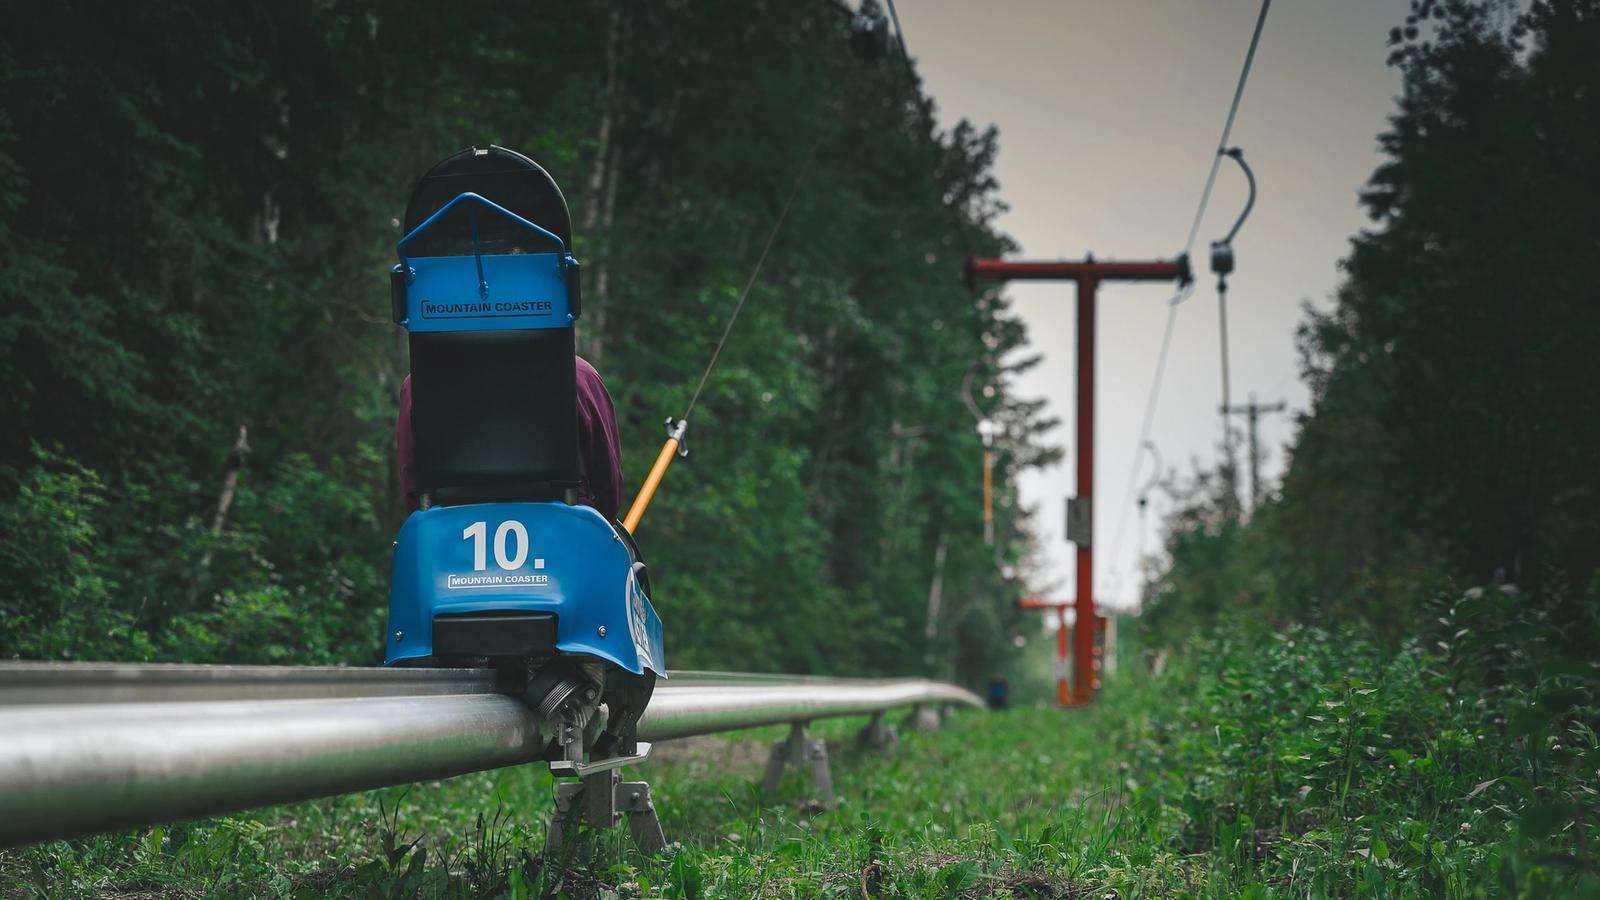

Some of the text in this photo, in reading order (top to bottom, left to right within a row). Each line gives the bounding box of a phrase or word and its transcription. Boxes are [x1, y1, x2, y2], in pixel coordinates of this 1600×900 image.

[426, 301, 552, 313] MOUNTAIN COASTER
[463, 521, 545, 570] 10.
[452, 575, 548, 585] MOUNTAIN COASTER
